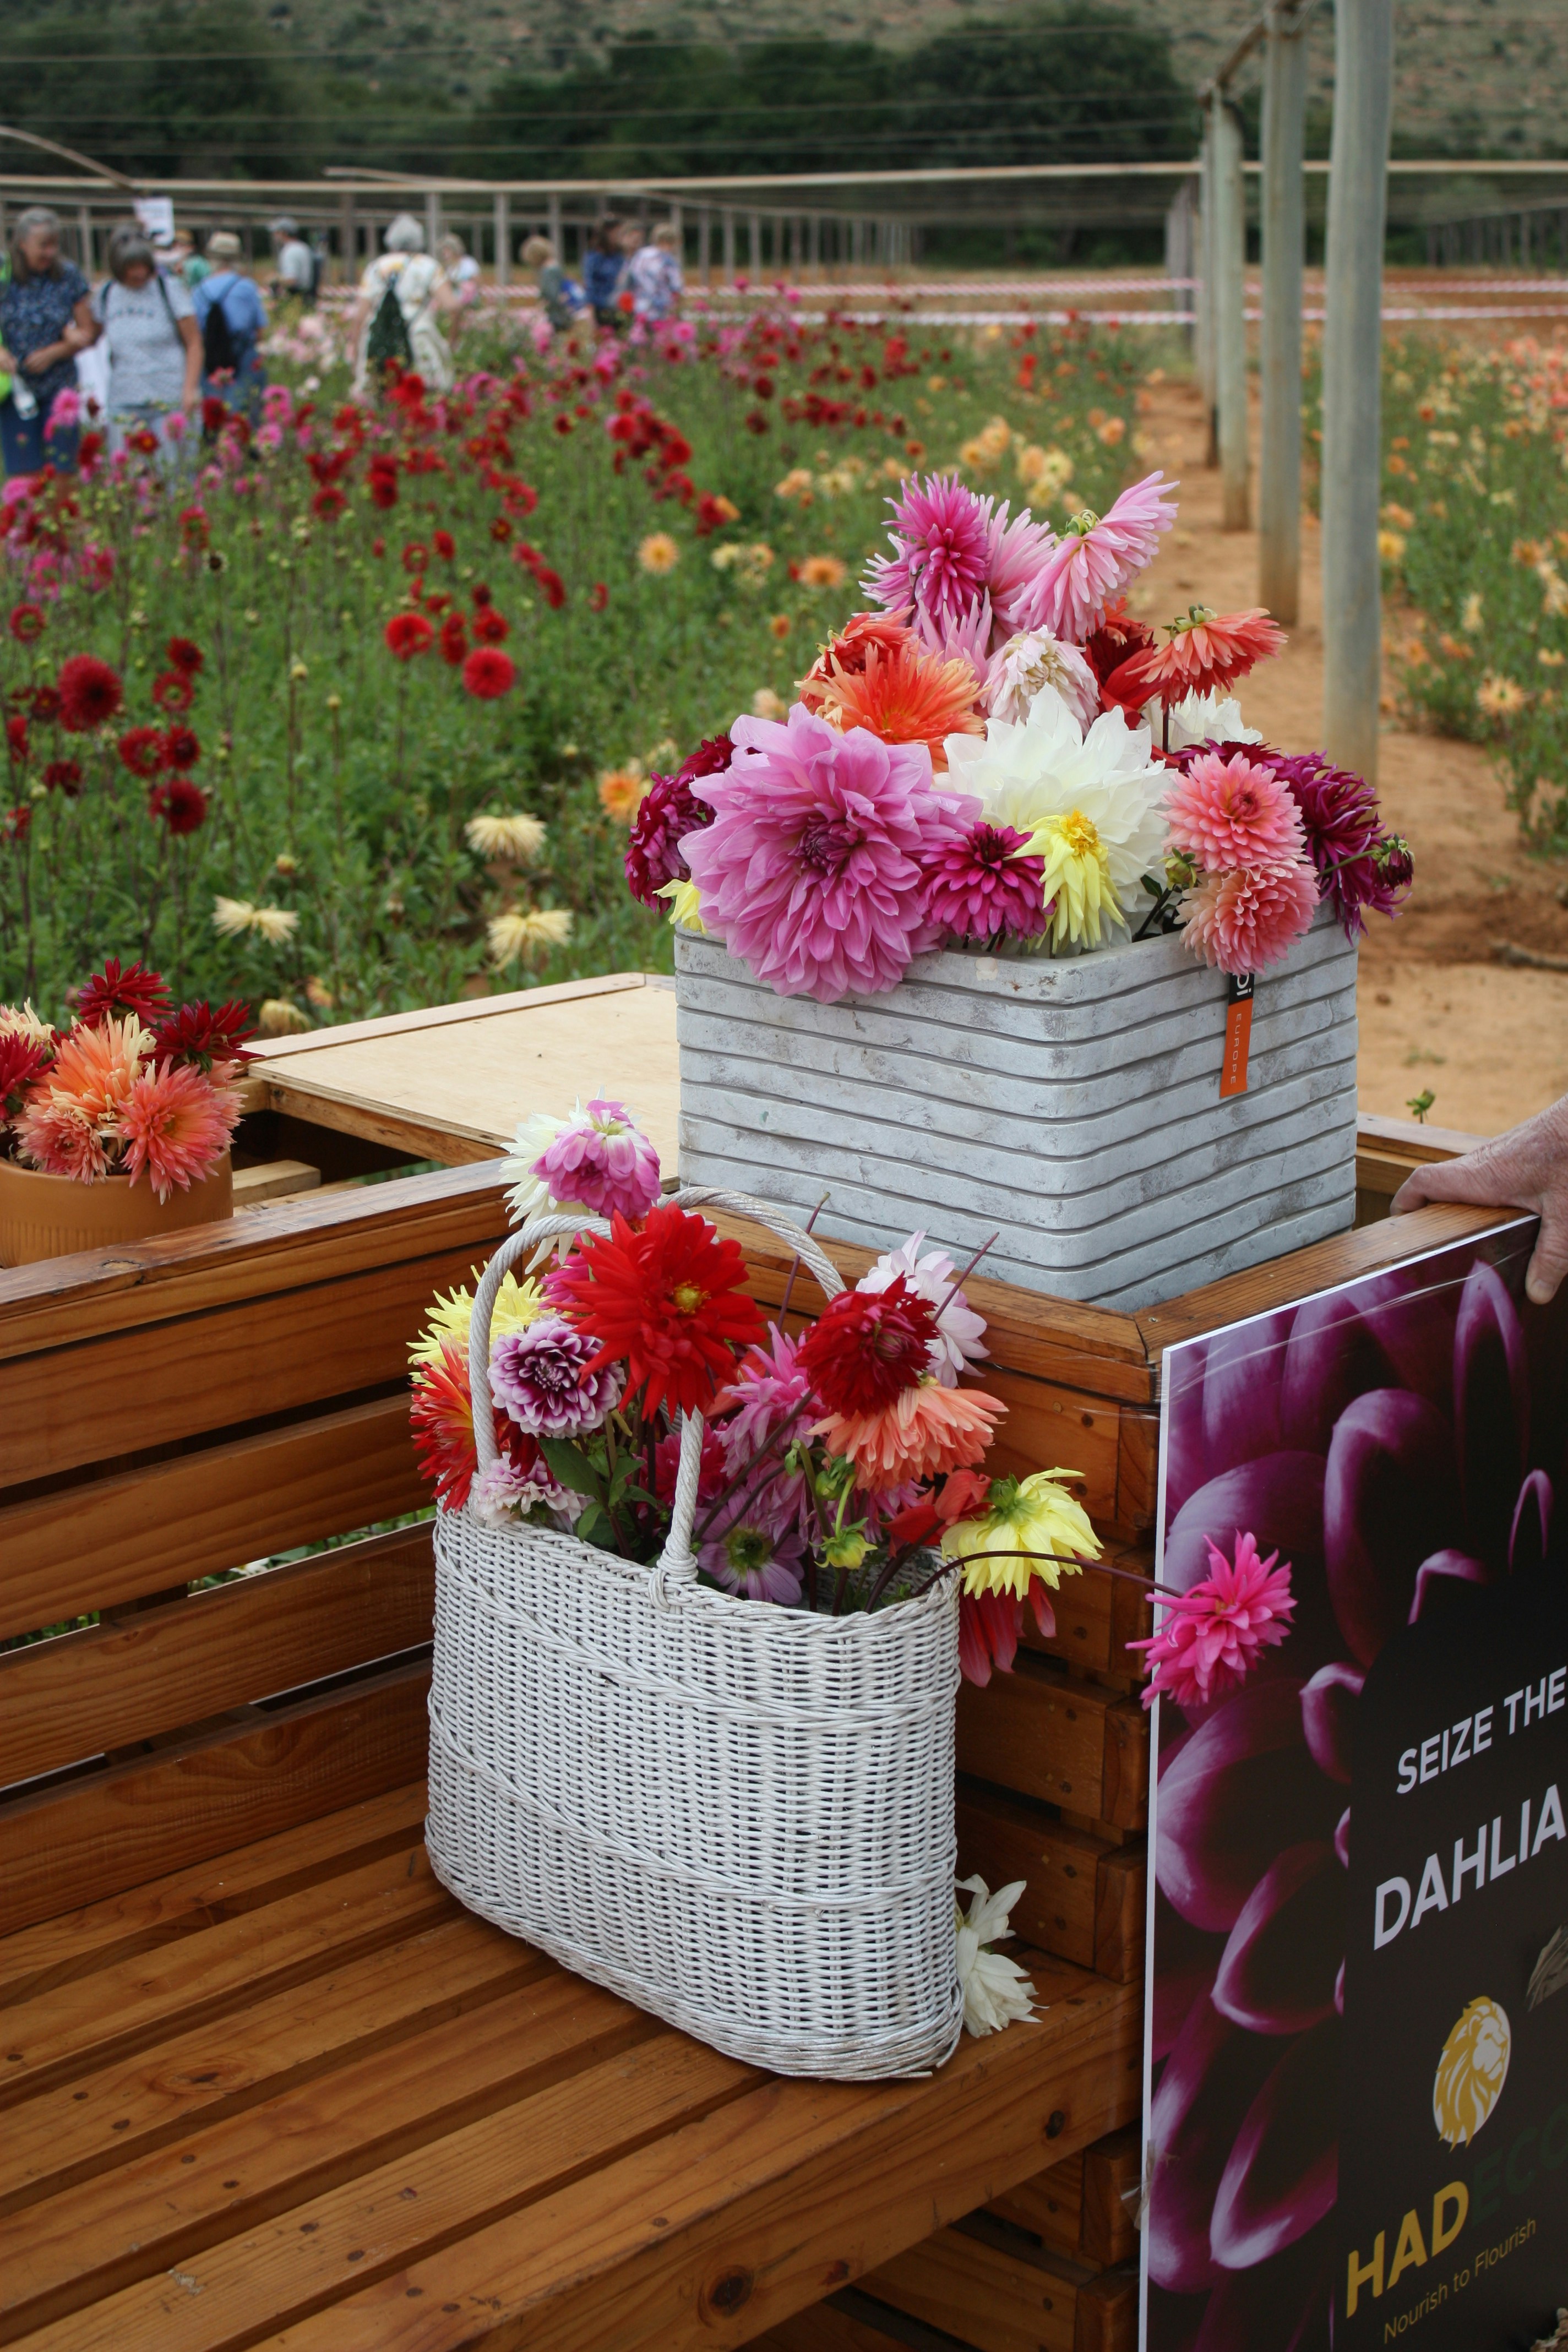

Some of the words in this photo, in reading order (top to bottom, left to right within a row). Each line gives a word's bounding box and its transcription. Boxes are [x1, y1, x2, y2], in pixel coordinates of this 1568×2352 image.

[1231, 1013, 1242, 1084] EUROPE
[1397, 1706, 1494, 1794] SEIZE
[1504, 1666, 1567, 1735] THE
[1374, 1784, 1566, 1951] DAHLIA
[1384, 2283, 1449, 2344] Nourish
[1453, 2268, 1471, 2294] to
[1474, 2218, 1537, 2277] Flourish
